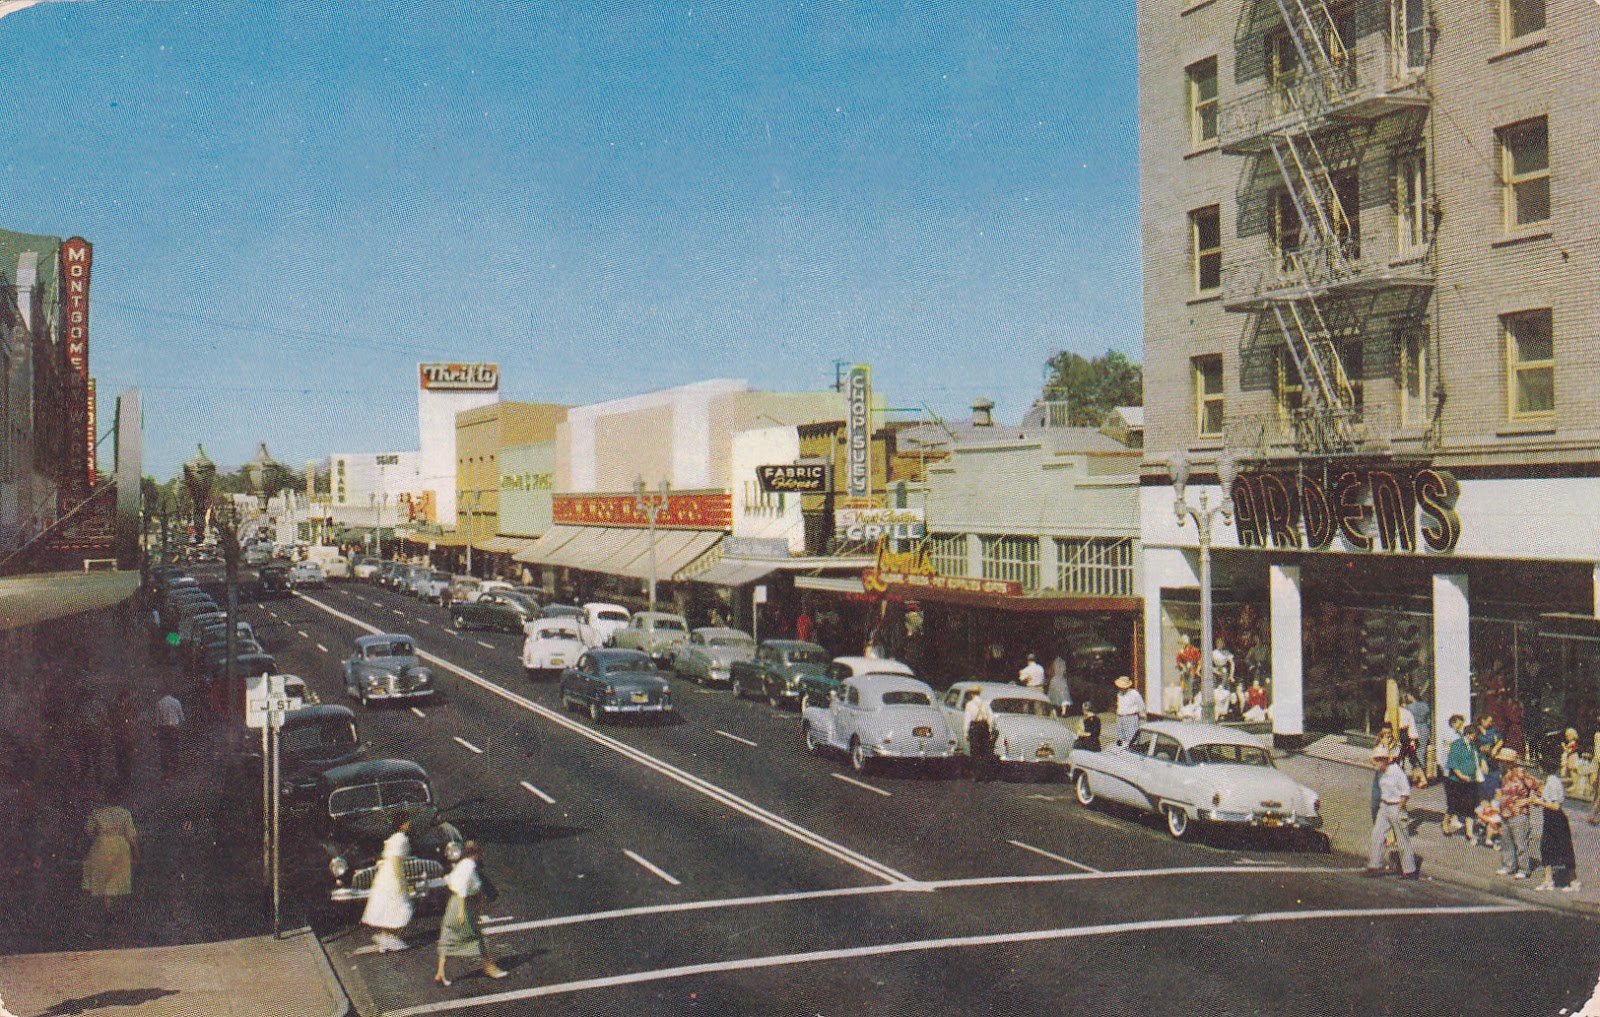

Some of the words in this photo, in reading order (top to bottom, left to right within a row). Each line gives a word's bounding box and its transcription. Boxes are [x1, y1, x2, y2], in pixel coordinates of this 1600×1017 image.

[423, 365, 497, 388] Thrifty
[852, 375, 865, 430] CHOP
[765, 467, 822, 478] FABRIC
[853, 436, 866, 491] SUEY
[1232, 468, 1461, 556] ARDENS
[847, 523, 921, 541] GRILL
[260, 699, 270, 711] J
[277, 699, 292, 711] ST
